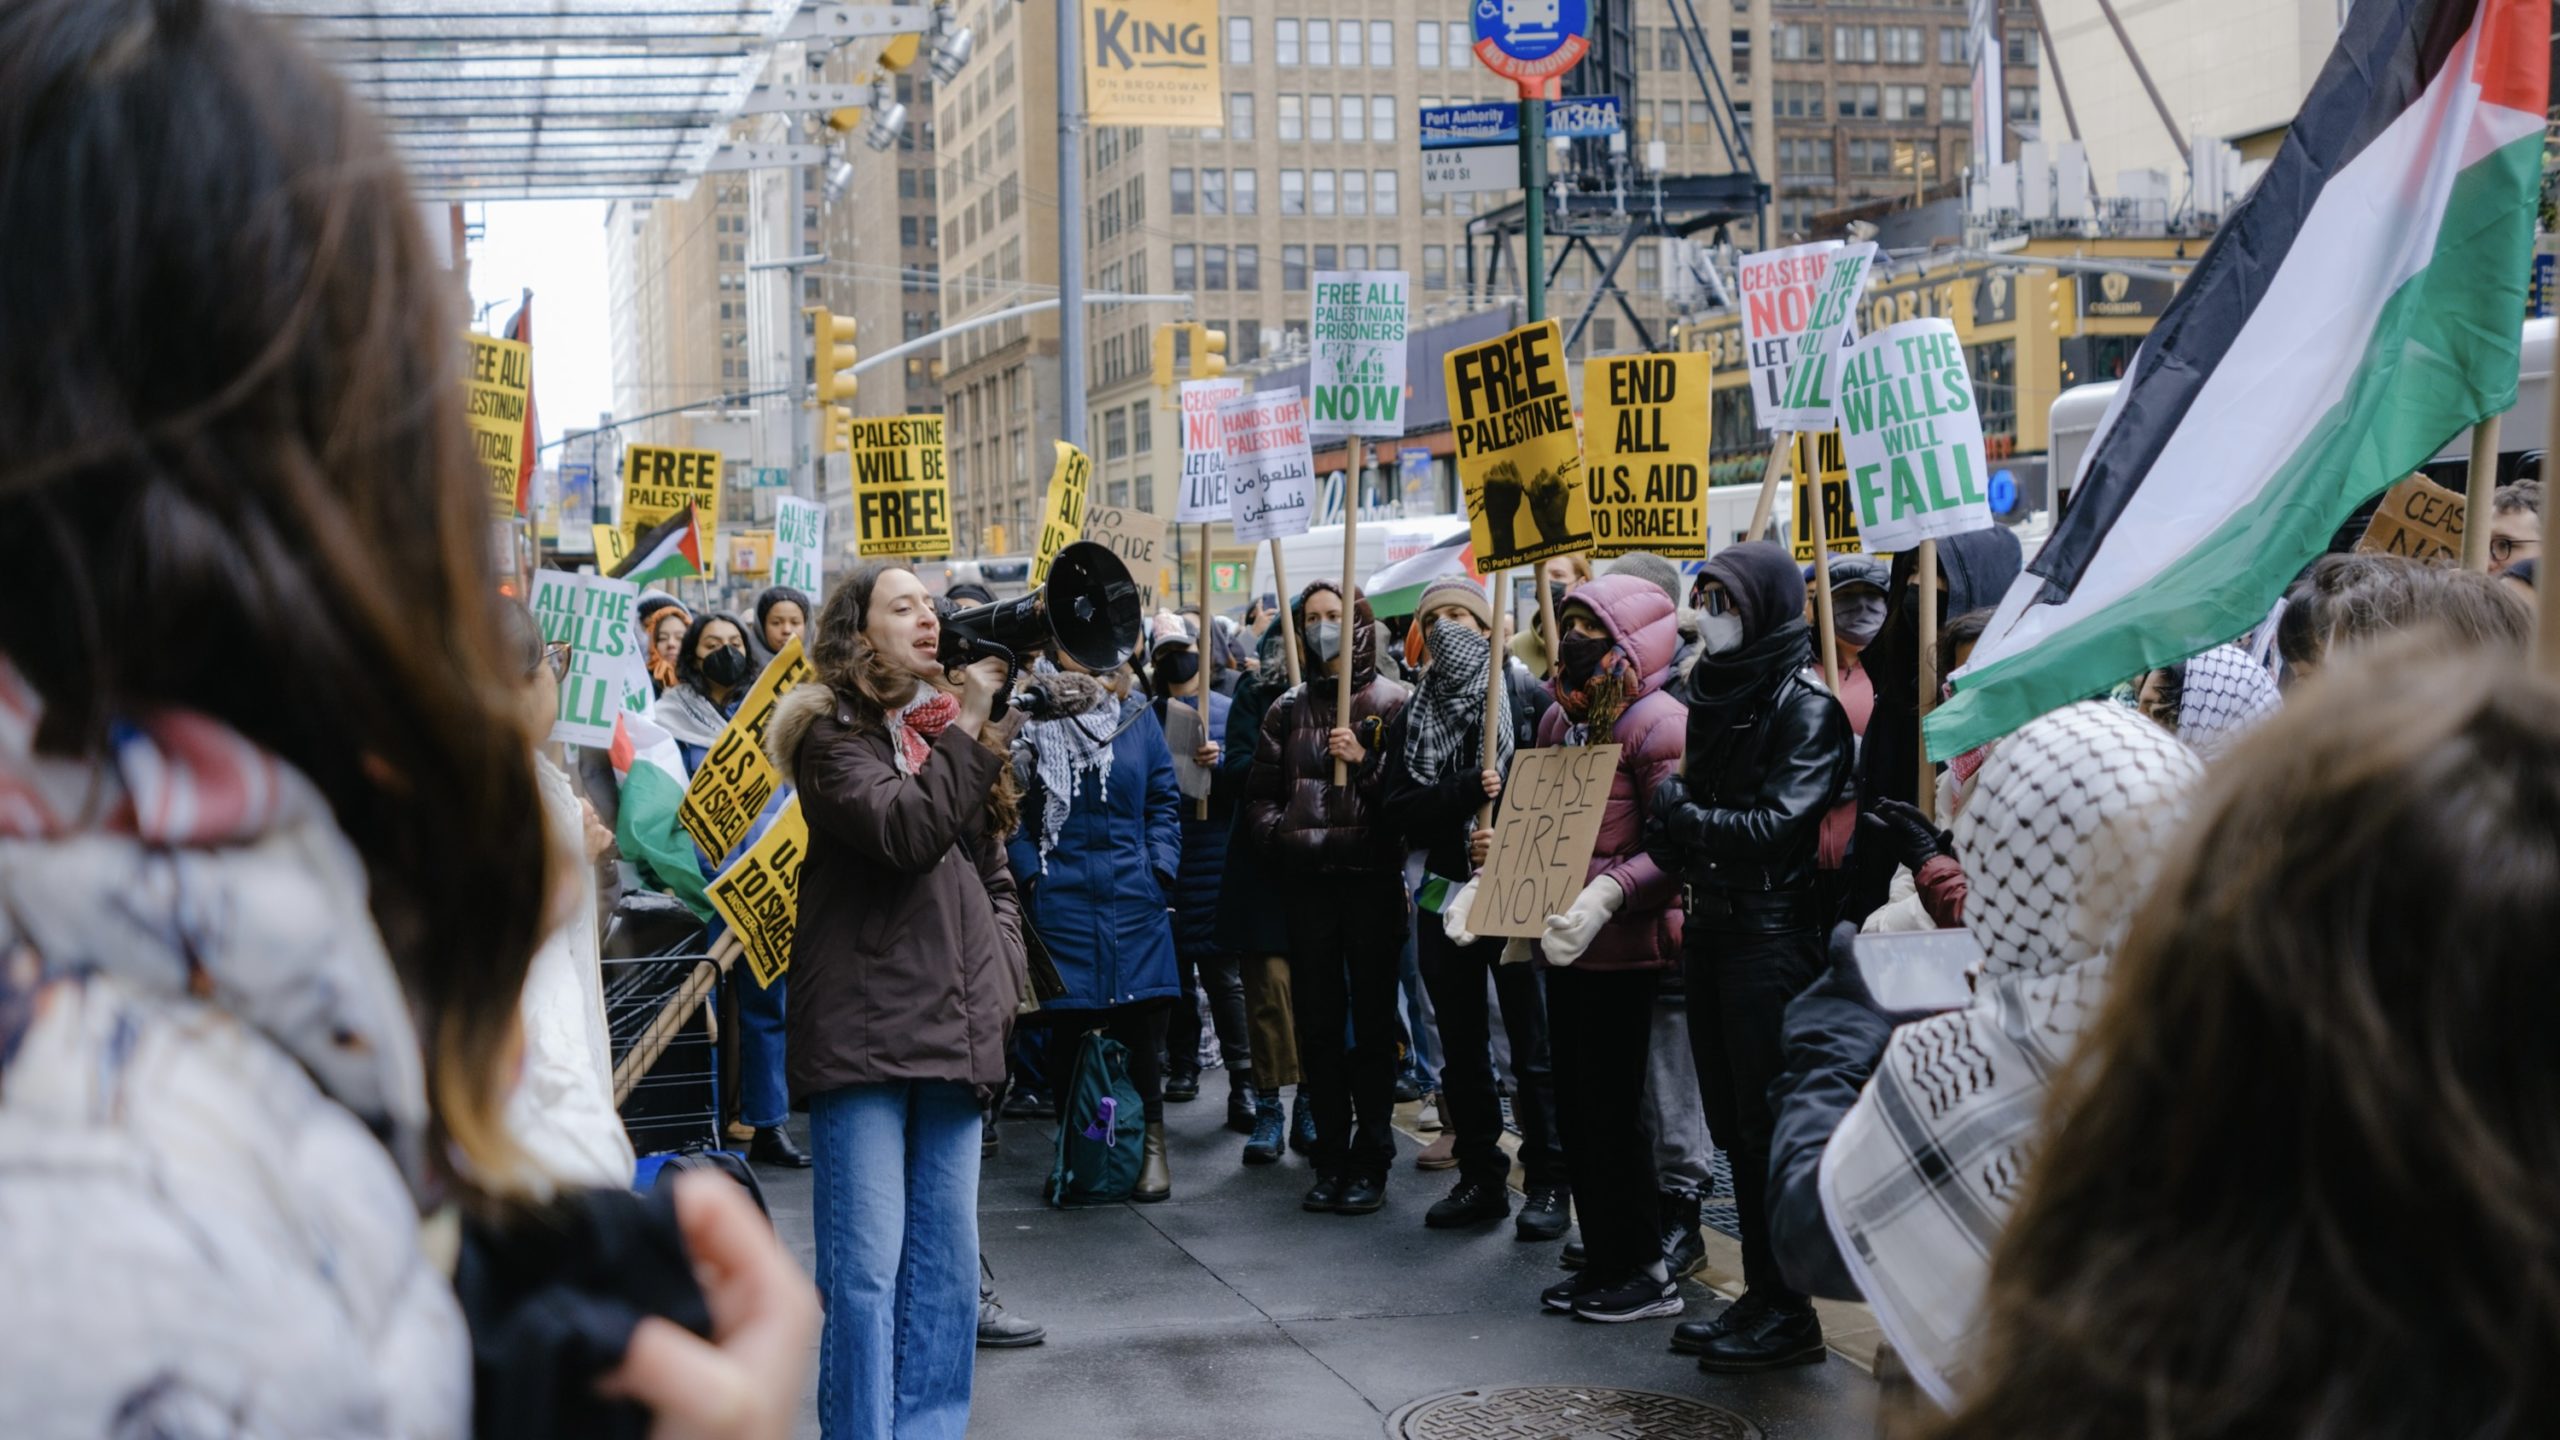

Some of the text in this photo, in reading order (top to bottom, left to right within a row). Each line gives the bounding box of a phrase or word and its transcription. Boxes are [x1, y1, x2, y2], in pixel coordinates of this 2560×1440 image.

[1094, 8, 1206, 70] KING
[1483, 38, 1580, 75] NO STANDING
[1097, 79, 1209, 91] ON BROADWAY
[1111, 93, 1196, 105] SINCE 1997
[1425, 108, 1504, 126] Port Authority
[1450, 123, 1500, 138] Terminal
[1551, 102, 1618, 132] M34A
[1427, 169, 1438, 181] W
[1459, 167, 1471, 179] St
[1436, 153, 1451, 164] Av
[1830, 255, 1867, 292] THE
[1316, 283, 1405, 305] FREE ALL
[1315, 307, 1404, 322] PALESTINIAN
[1315, 323, 1405, 341] PRISONERS
[500, 349, 525, 389] ALL
[1752, 338, 1789, 368] LET
[1841, 345, 1893, 393] ALL
[1896, 332, 1961, 374] THE
[1454, 326, 1556, 421] FREE
[1610, 359, 1676, 406] END
[1222, 402, 1301, 434] HANDS OFF
[1315, 384, 1400, 421] NOW
[1842, 368, 1970, 436] WALLS
[852, 420, 942, 449] PALESTINE
[1189, 412, 1223, 451] NO
[1226, 424, 1306, 456] PALESTINE
[1456, 395, 1573, 458] PALESTINE
[1615, 407, 1669, 454] ALL
[1881, 420, 1944, 457] WILL
[631, 447, 715, 489] FREE
[856, 449, 944, 484] WILL BE
[1187, 452, 1208, 476] LET
[1234, 461, 1307, 495] اطلعوا من
[1190, 473, 1228, 508] LIVE!
[1589, 463, 1698, 504] U.S. AID
[1855, 443, 1986, 528] FALL
[859, 488, 947, 540] FREE!
[1084, 507, 1123, 529] NO
[1243, 492, 1305, 522] فلسطين
[1617, 507, 1698, 537] ISRAEL!
[1665, 548, 1704, 557] Liberation
[535, 582, 633, 624] ALL THE
[691, 763, 714, 796] TO
[711, 728, 756, 793] U.S.
[737, 772, 771, 822] AID
[1510, 751, 1607, 812] CEASE
[699, 784, 748, 849] ISRAEL!
[1494, 810, 1584, 876] FIRE
[735, 857, 769, 898] TO
[1483, 875, 1572, 929] NOW
